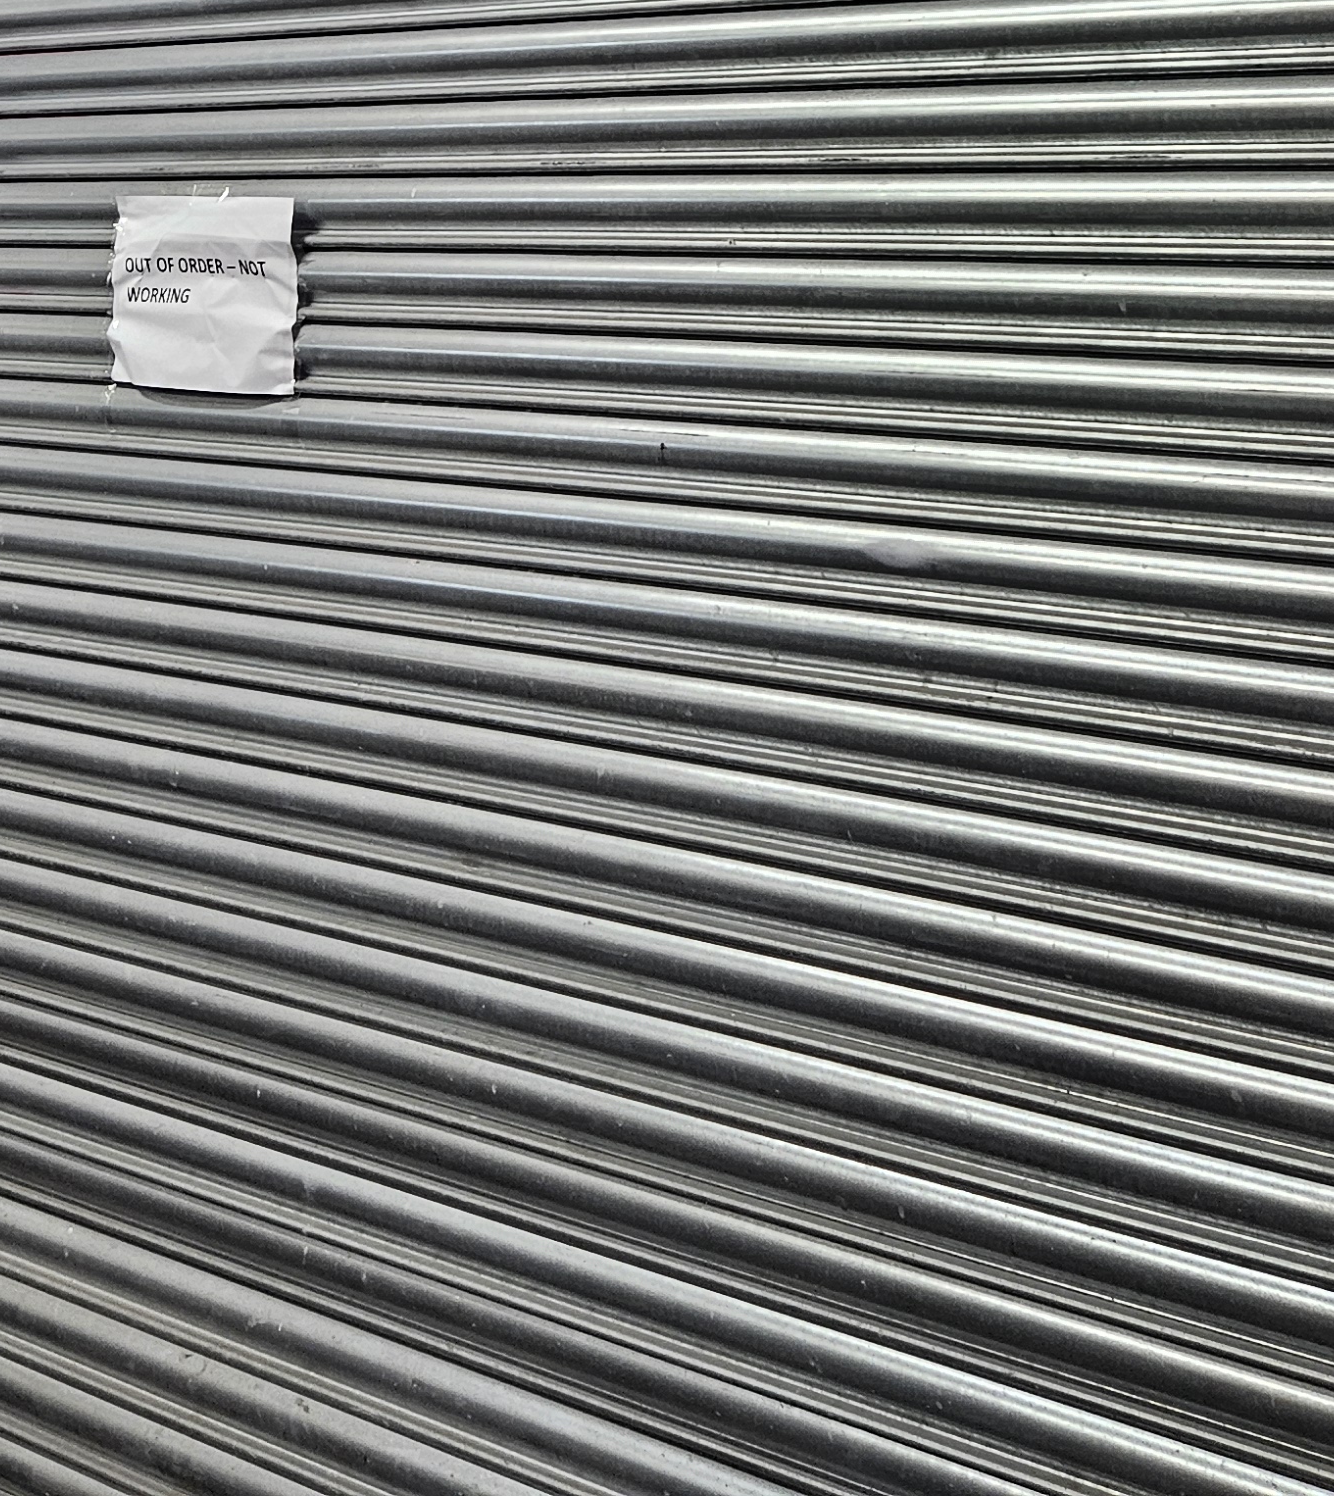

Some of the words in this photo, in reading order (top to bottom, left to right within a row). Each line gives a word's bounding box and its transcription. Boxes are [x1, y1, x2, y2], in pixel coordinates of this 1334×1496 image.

[125, 257, 151, 274] OUT
[156, 257, 174, 273] OF
[178, 257, 225, 275] ORDER
[238, 259, 266, 277] NOT
[127, 286, 191, 304] WORKING
